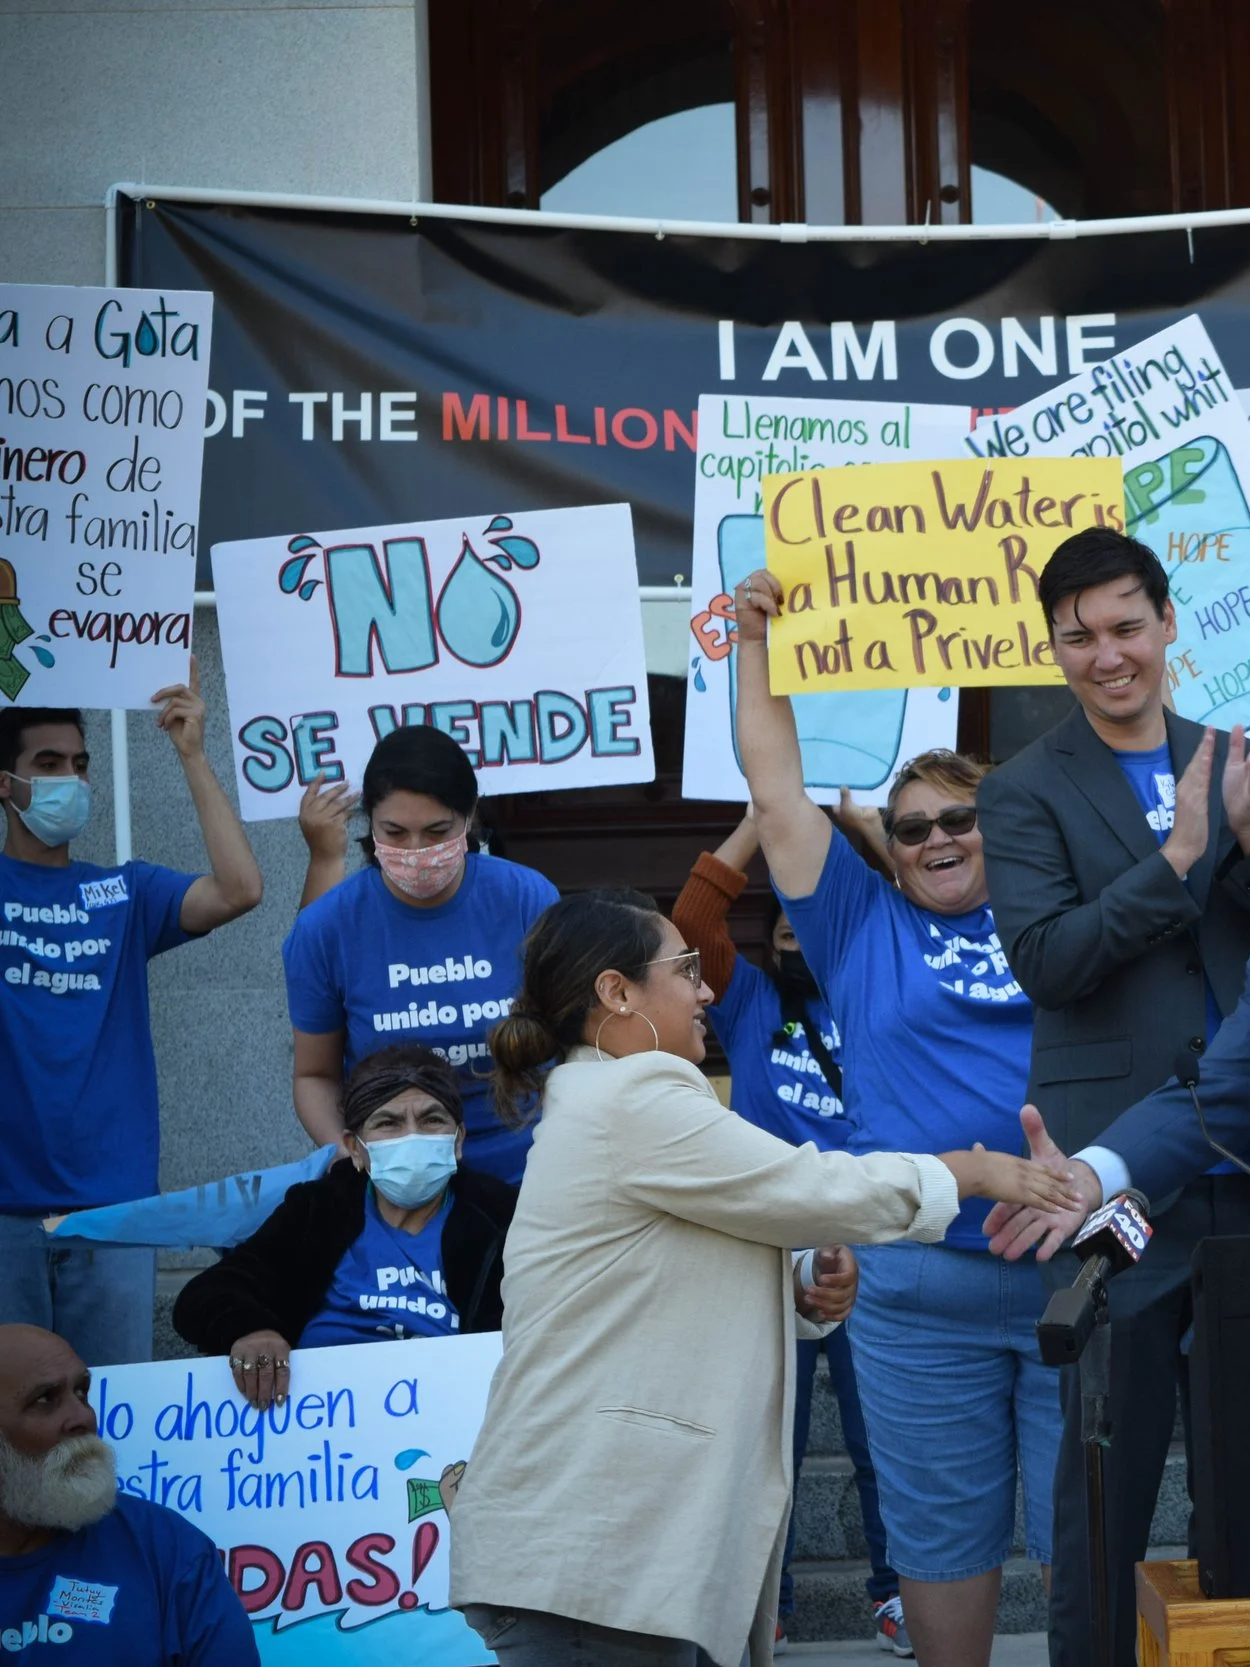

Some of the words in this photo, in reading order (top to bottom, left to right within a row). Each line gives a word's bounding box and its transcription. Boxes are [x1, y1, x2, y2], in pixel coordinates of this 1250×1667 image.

[46, 315, 74, 354] a
[95, 296, 199, 368] Gota
[718, 319, 736, 380] I
[762, 319, 898, 381] AM
[929, 313, 1117, 380] ONE
[83, 383, 183, 429] como
[289, 392, 417, 441] THE
[442, 392, 698, 452] MILLION
[722, 399, 868, 447] Llenamos
[881, 405, 910, 449] al
[964, 419, 1030, 459] We
[1032, 391, 1095, 444] are
[1090, 344, 1197, 412] filing
[0, 437, 87, 485] nero
[106, 435, 162, 493] de
[0, 485, 48, 541] tra
[66, 492, 196, 557] familia
[770, 475, 926, 545] Clean
[931, 469, 1079, 532] Water
[1166, 531, 1234, 563] HOPE
[76, 561, 122, 597] se
[788, 582, 817, 614] a
[824, 540, 999, 608] Human
[48, 608, 190, 669] evapora
[793, 618, 854, 681] not
[863, 639, 898, 672] a
[903, 607, 1060, 675] Privele
[239, 710, 344, 793] SE
[4, 902, 90, 925] Pueblo
[4, 963, 31, 985] el
[33, 972, 102, 995] agua
[64, 938, 112, 963] por
[388, 955, 493, 988] Pueblo
[373, 1000, 458, 1032] unido
[461, 996, 516, 1028] por
[777, 1082, 803, 1104] el
[1113, 1213, 1145, 1249] 40
[1123, 1199, 1149, 1233] FOX
[359, 1294, 447, 1319] unido
[154, 1371, 355, 1464] ahoguen
[384, 1378, 419, 1417] a
[221, 1440, 380, 1511] familia
[218, 1521, 440, 1612] DAS!
